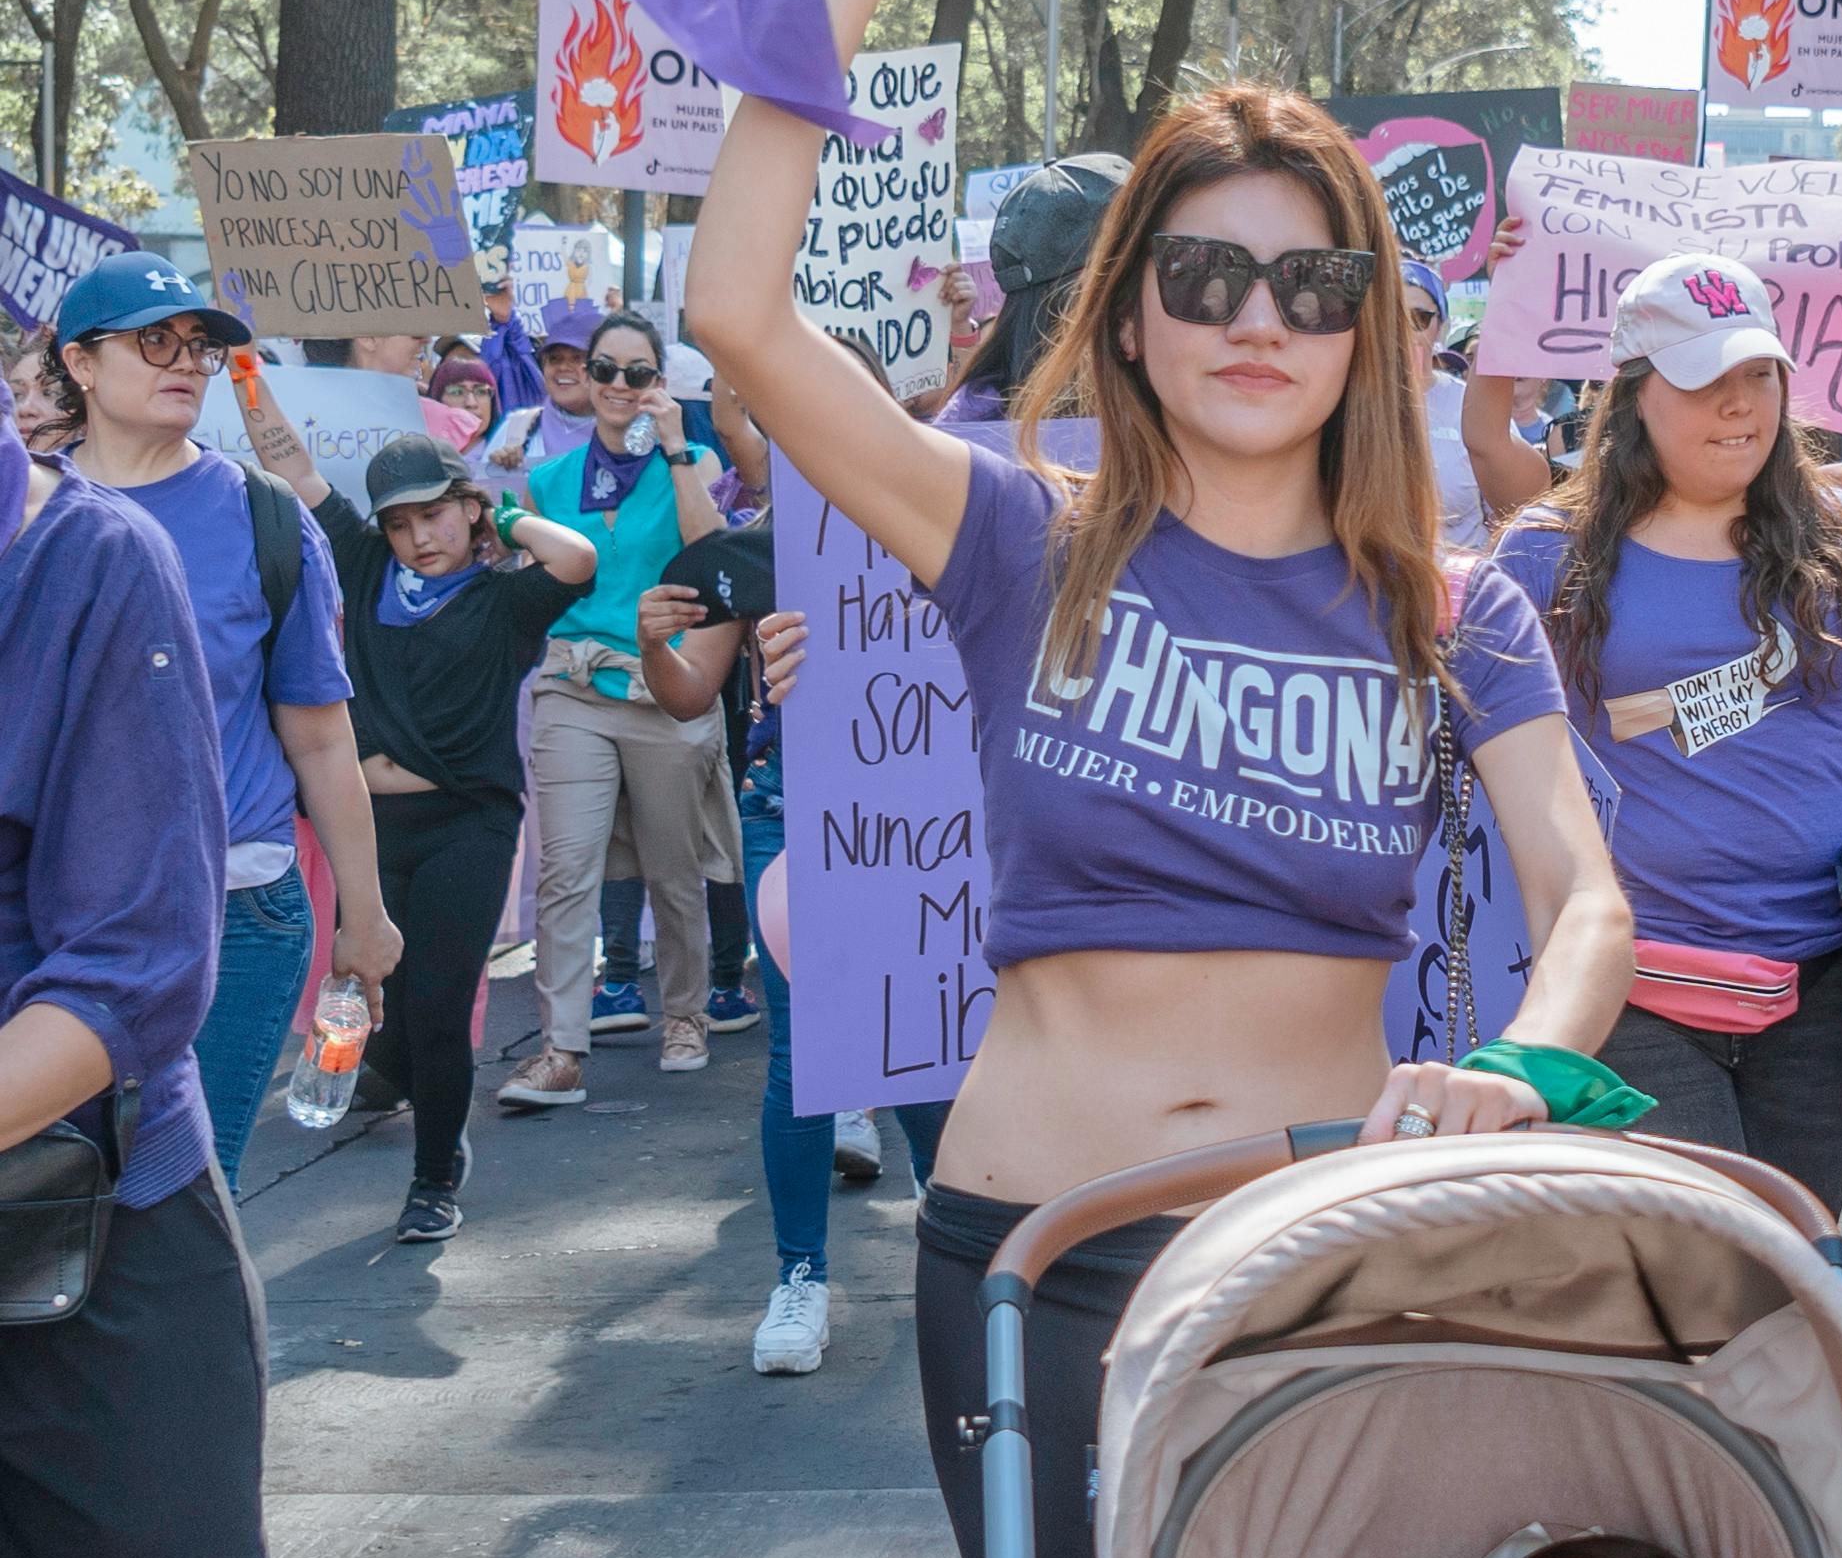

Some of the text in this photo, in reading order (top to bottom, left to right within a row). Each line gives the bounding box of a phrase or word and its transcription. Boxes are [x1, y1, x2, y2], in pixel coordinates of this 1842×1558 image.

[1798, 48, 1811, 58] EN
[1813, 48, 1828, 58] UN
[652, 117, 719, 134] EN UN PAIS
[1570, 90, 1620, 123] SER
[200, 151, 411, 205] YO NO SOY UNA
[1427, 151, 1447, 180] el
[1439, 174, 1471, 198] De
[1538, 152, 1627, 185] UNA
[1650, 170, 1722, 201] SE
[1401, 192, 1486, 243] las que no
[1533, 172, 1810, 236] FEMINISTA
[1541, 205, 1632, 240] CON
[2, 194, 47, 259] NI
[348, 218, 399, 251] SOY
[838, 202, 948, 266] puede
[1420, 222, 1472, 255] están
[528, 249, 563, 272] nos
[230, 266, 281, 299] UNA
[1045, 601, 1428, 806] CHINGONA
[1674, 670, 1723, 704] DON'T
[1681, 682, 1755, 724] WITH MY
[852, 671, 978, 766] SOM
[1690, 704, 1751, 748] ENERGY
[1013, 727, 1422, 857] MUJER EMPODERAD
[822, 801, 973, 872] Nunca
